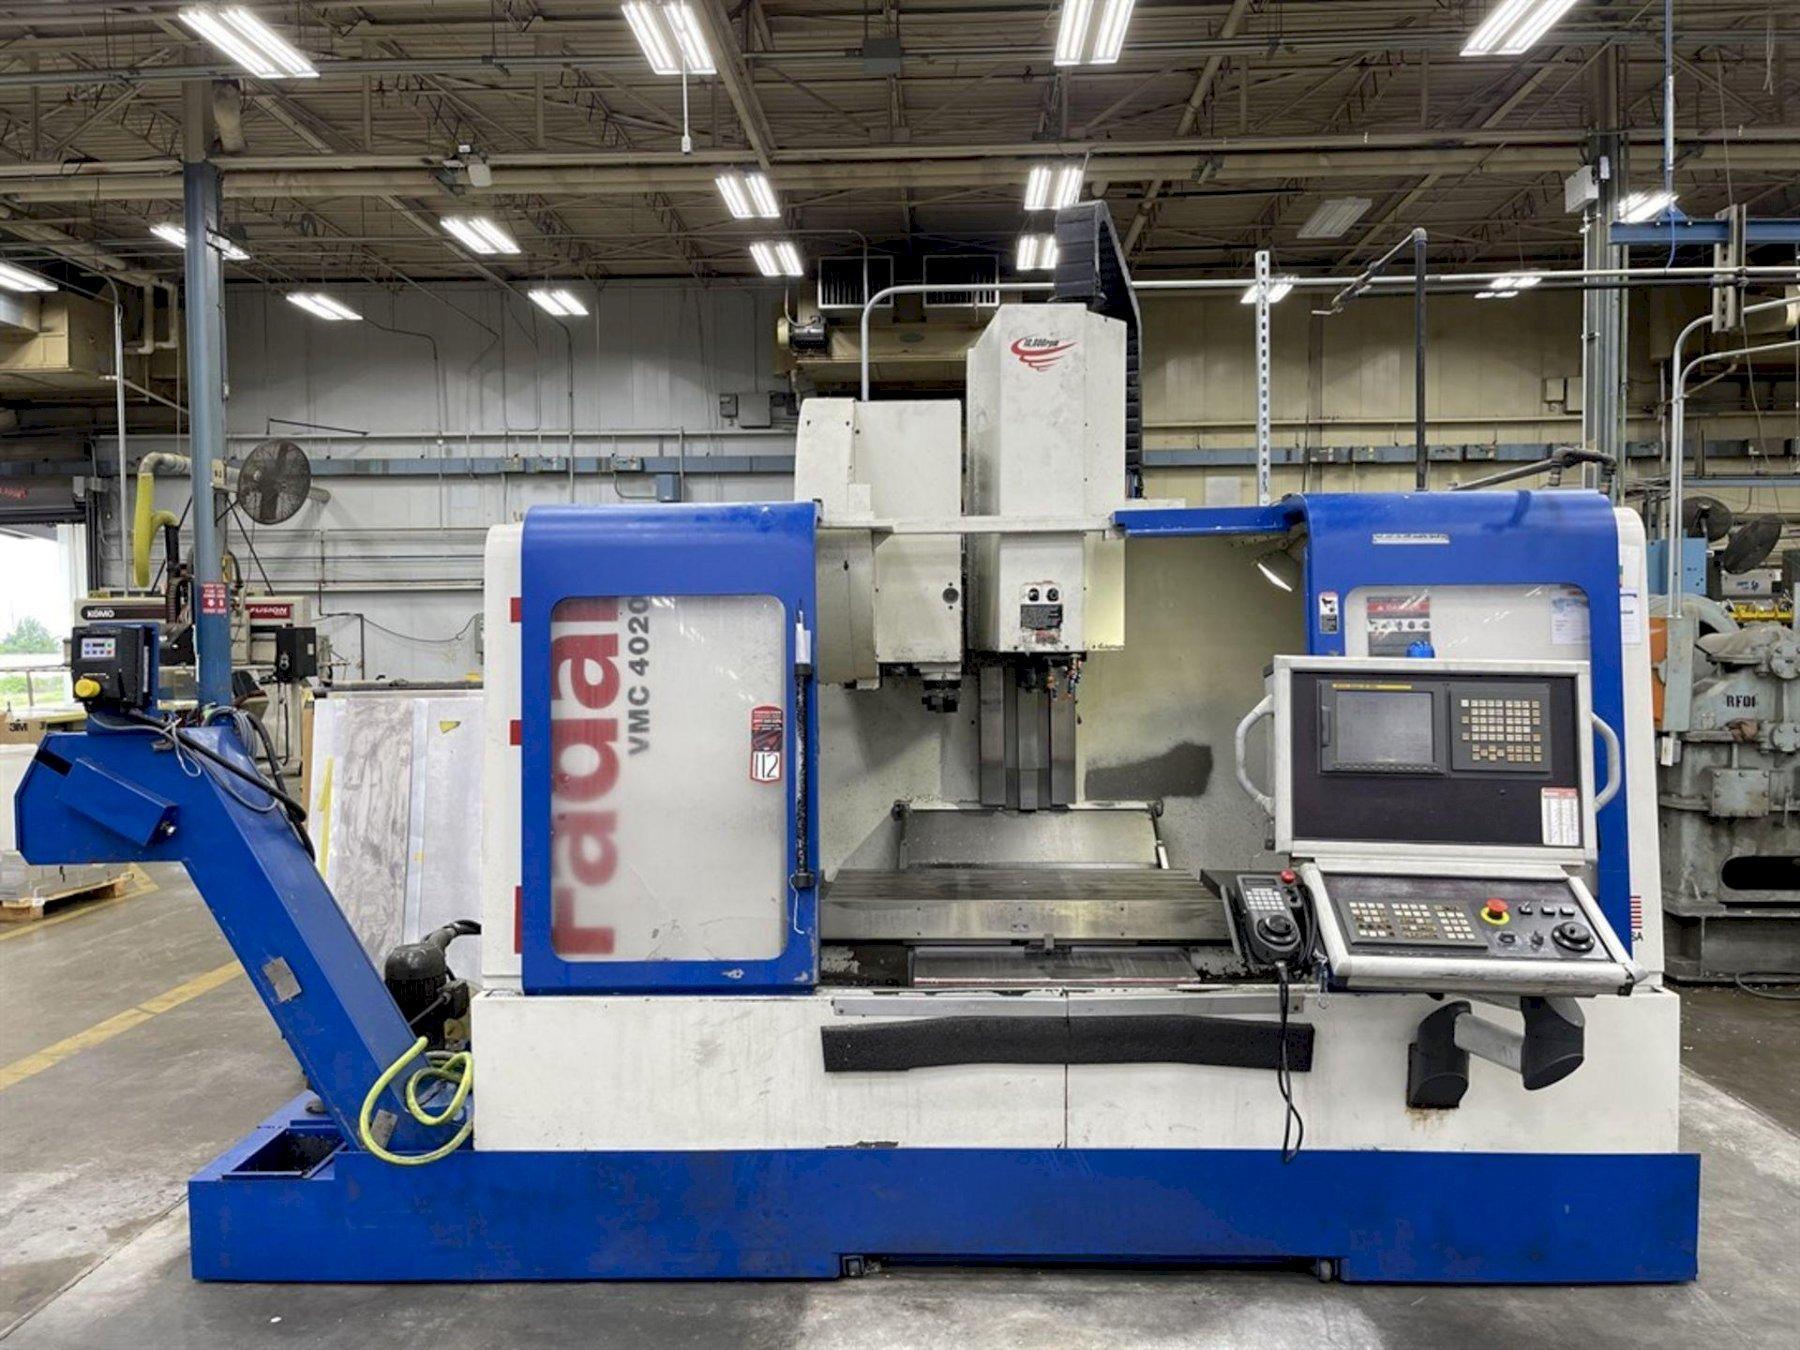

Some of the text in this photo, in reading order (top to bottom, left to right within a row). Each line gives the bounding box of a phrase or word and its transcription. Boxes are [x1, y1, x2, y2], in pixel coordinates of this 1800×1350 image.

[627, 597, 651, 755] VMC 4020
[9, 722, 28, 732] 3M
[755, 751, 779, 778] 112
